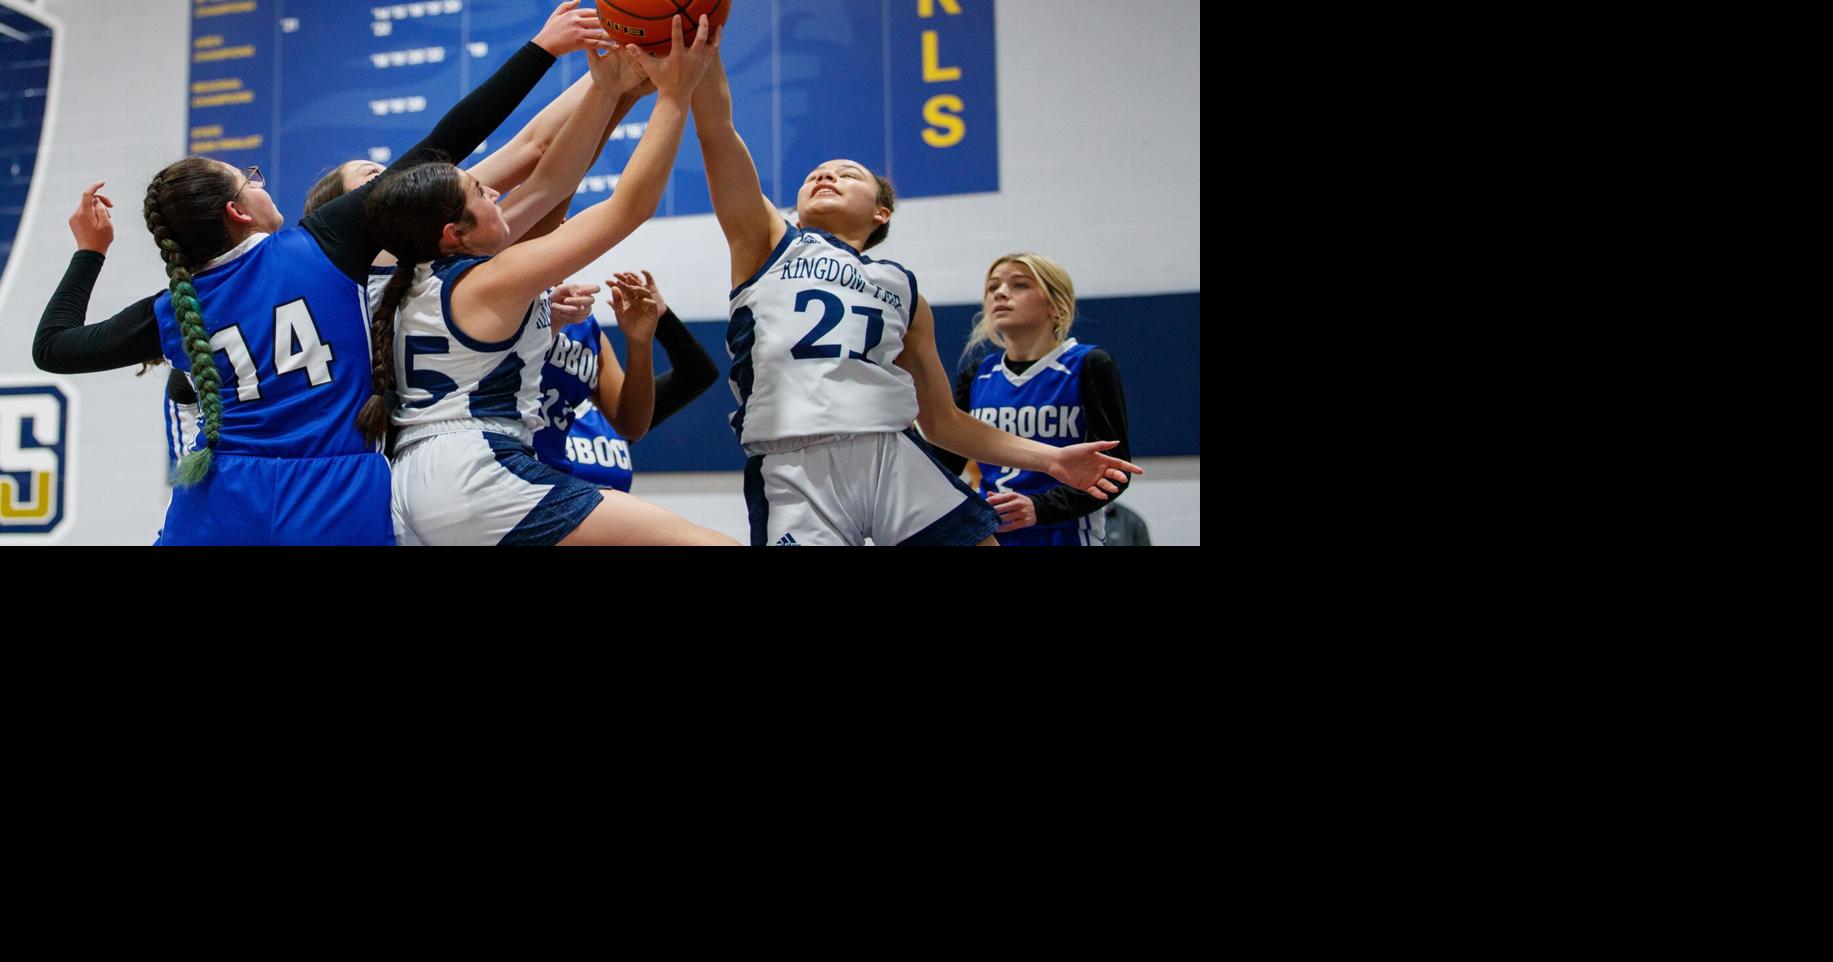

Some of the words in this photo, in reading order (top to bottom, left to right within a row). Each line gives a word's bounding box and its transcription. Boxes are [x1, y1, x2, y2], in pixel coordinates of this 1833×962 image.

[780, 257, 866, 292] KINGDOM
[207, 297, 335, 403] 14
[789, 288, 884, 363] 21
[405, 335, 460, 409] 5
